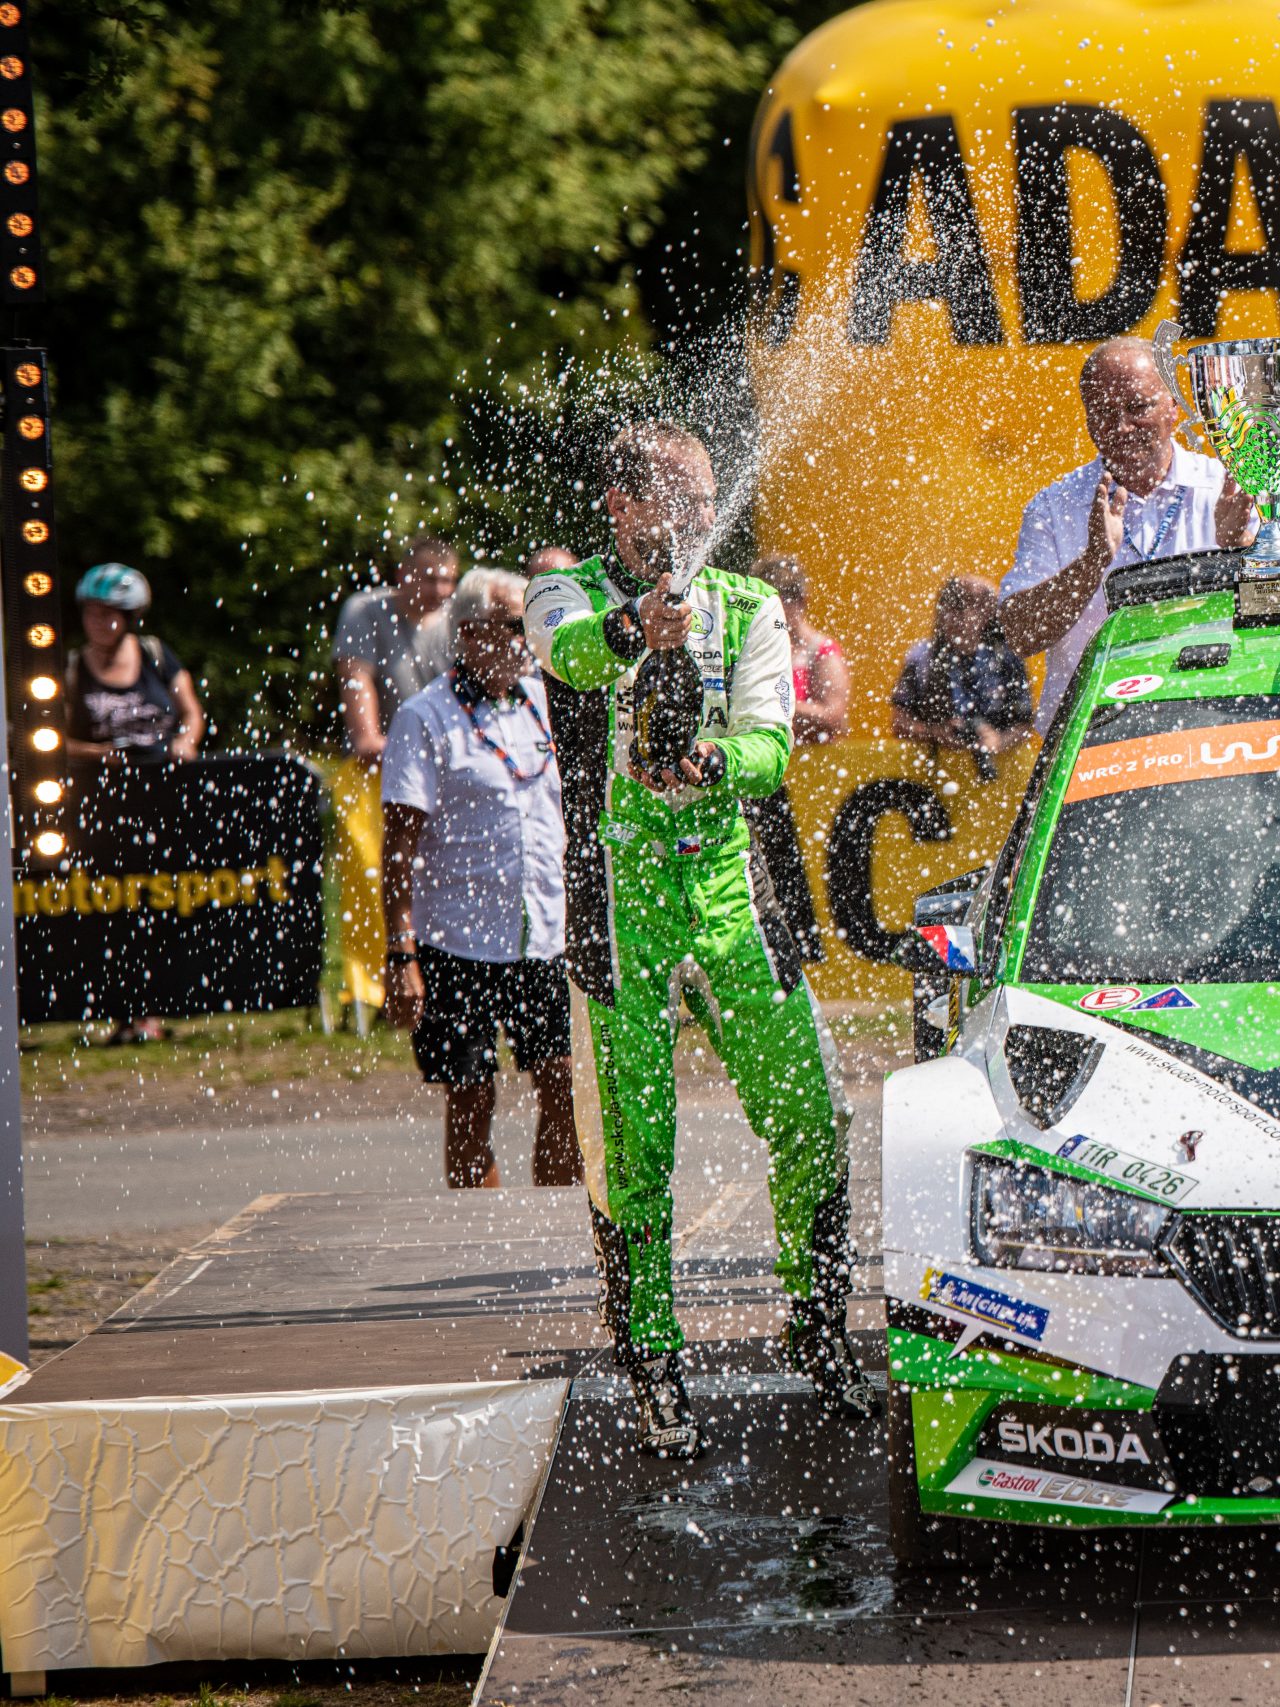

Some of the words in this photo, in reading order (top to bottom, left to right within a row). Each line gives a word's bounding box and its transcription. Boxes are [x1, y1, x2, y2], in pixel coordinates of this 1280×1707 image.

[1078, 763, 1120, 783] WRC
[1126, 760, 1137, 772] 2
[1145, 753, 1183, 769] PRO
[605, 823, 636, 841] OMP
[1121, 1161, 1185, 1196] 0426
[956, 1289, 1039, 1330] MICHELIN
[998, 1414, 1152, 1466] ŠKODA
[990, 1470, 1043, 1494] Castrol
[1038, 1476, 1143, 1508] EDGE
